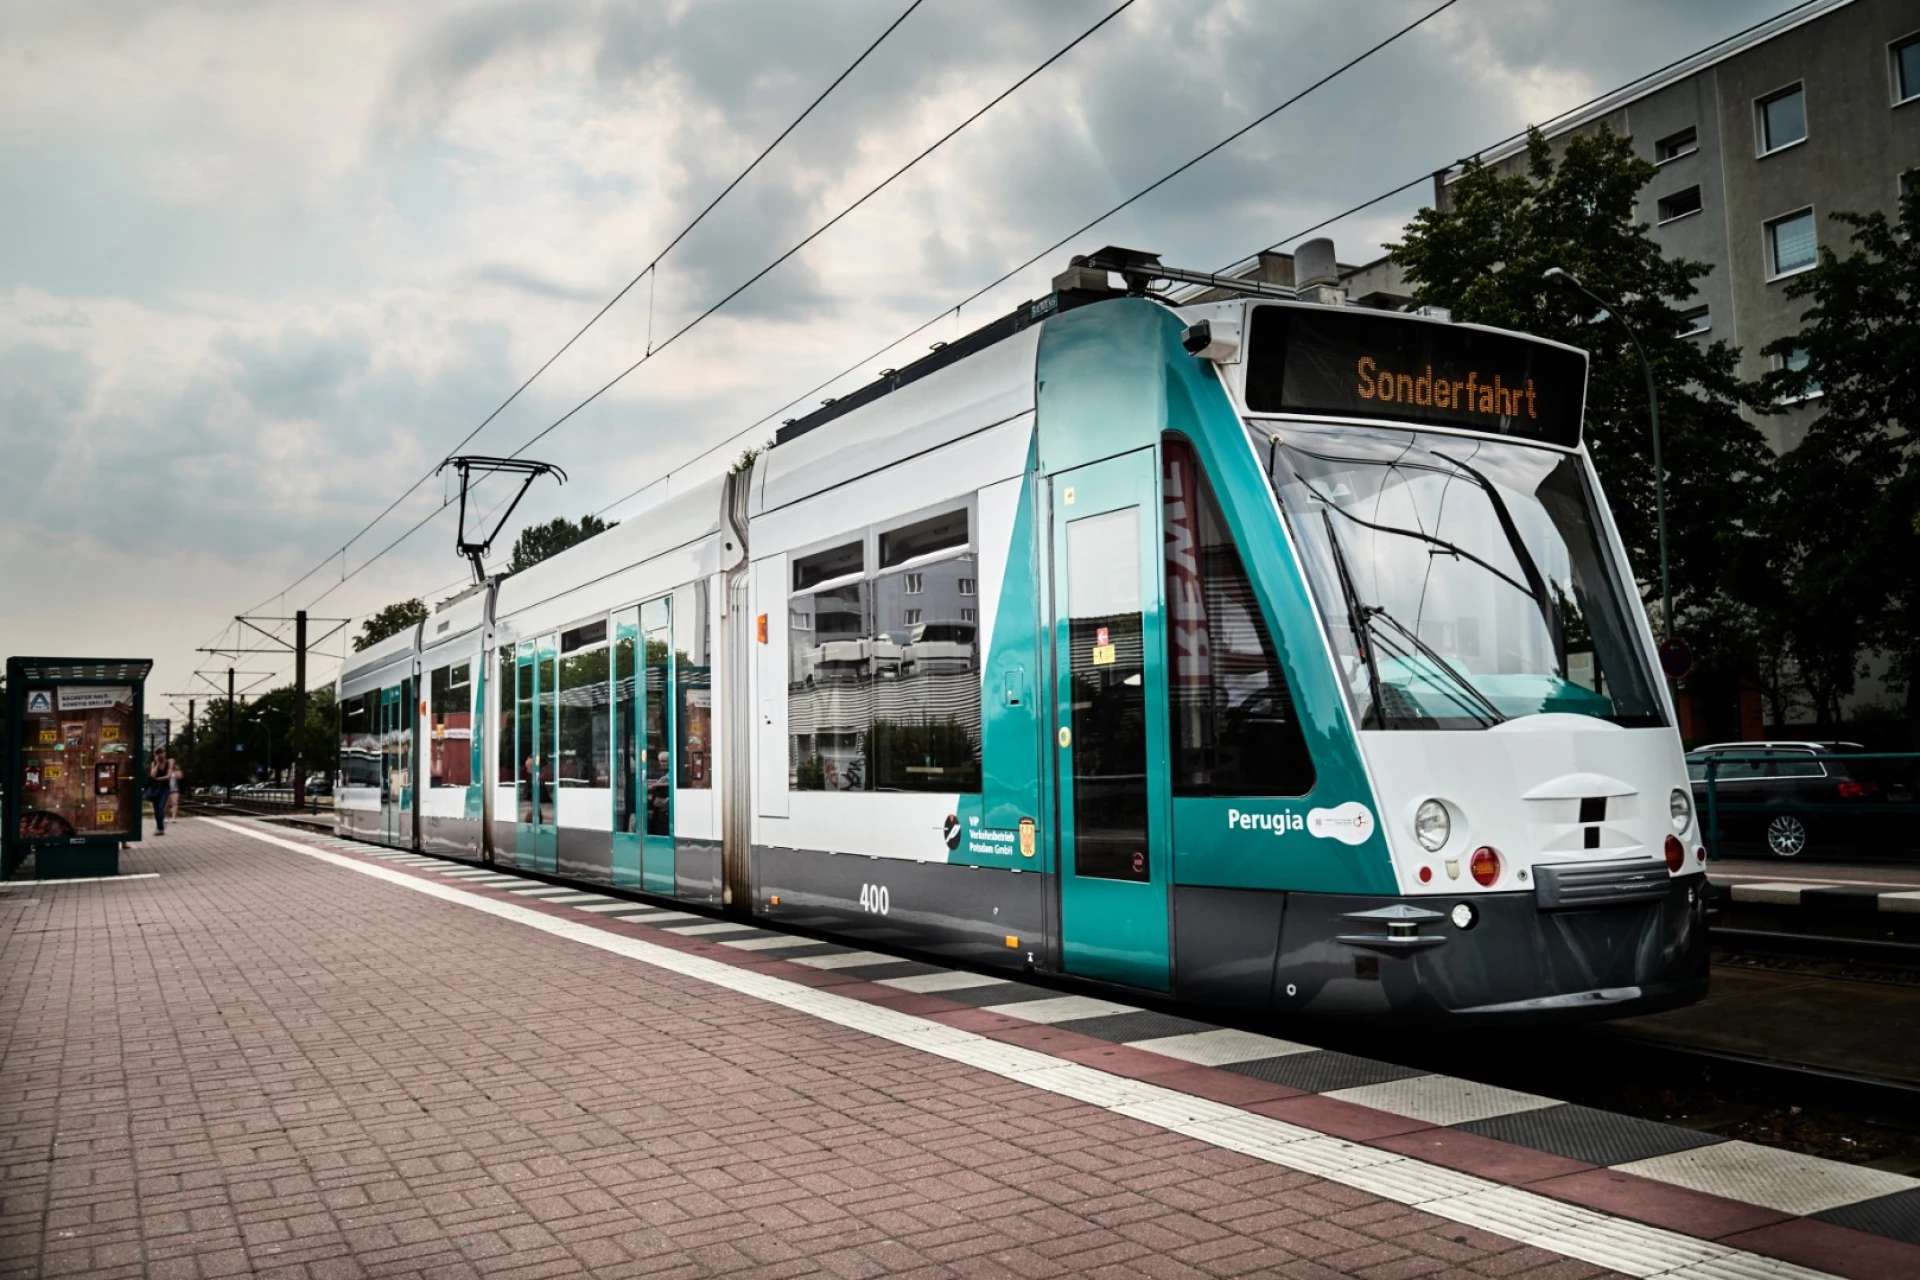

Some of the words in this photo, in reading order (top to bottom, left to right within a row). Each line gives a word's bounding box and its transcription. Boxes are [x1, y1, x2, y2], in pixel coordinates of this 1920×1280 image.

[1357, 356, 1538, 419] Sonderfahrt
[968, 828, 1015, 843] Verkehrsbetrieb
[1228, 808, 1304, 836] Perugia
[968, 841, 994, 854] Potsdam
[994, 843, 1013, 855] GmbH
[860, 883, 889, 916] 400
